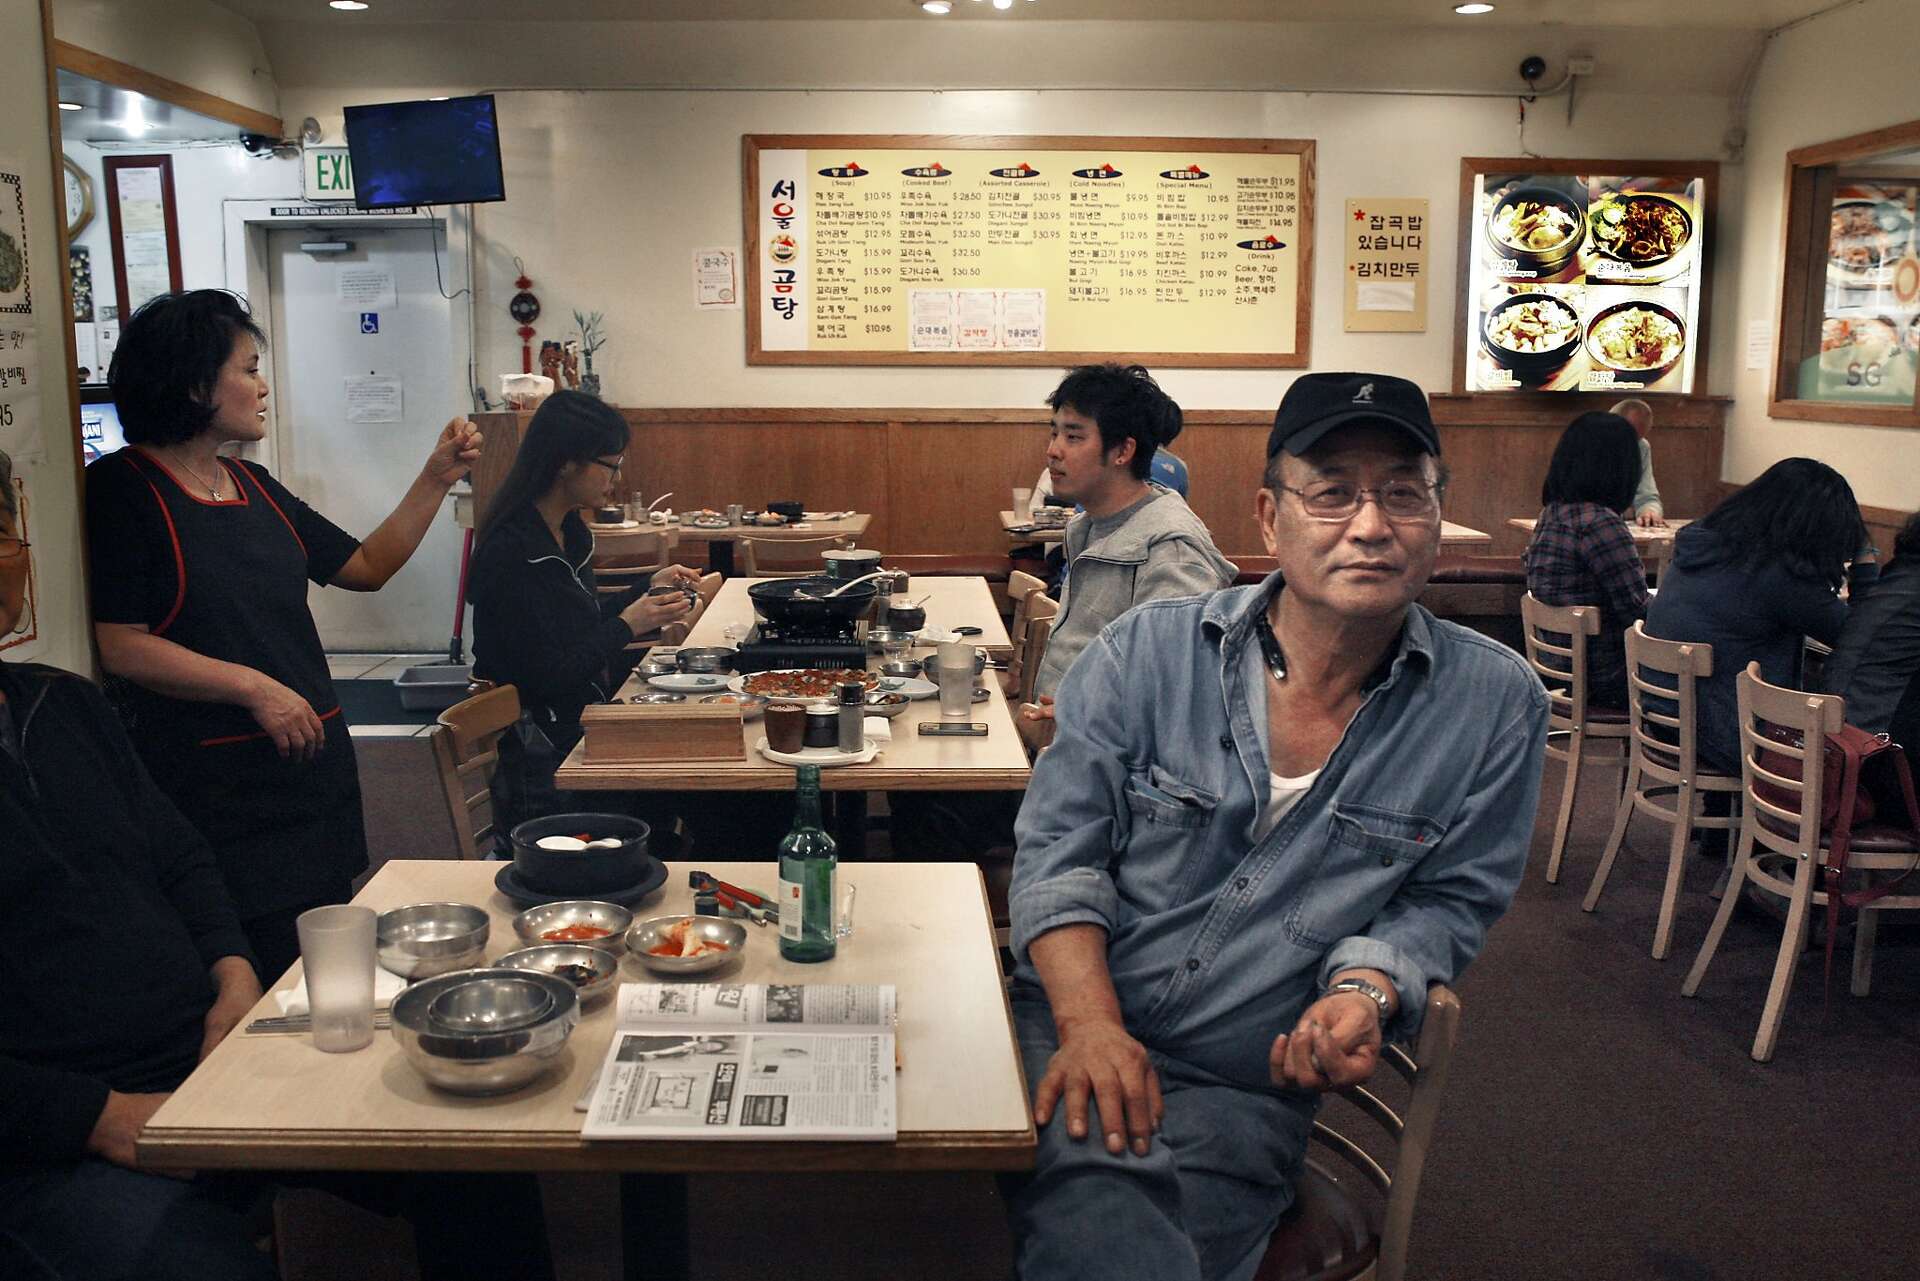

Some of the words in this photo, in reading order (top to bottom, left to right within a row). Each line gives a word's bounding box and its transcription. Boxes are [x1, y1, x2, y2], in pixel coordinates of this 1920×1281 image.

[317, 155, 351, 190] EXI
[1370, 216, 1423, 231] 잡곡밥
[1358, 235, 1423, 251] 있습니다
[1358, 262, 1420, 278] 김치만두
